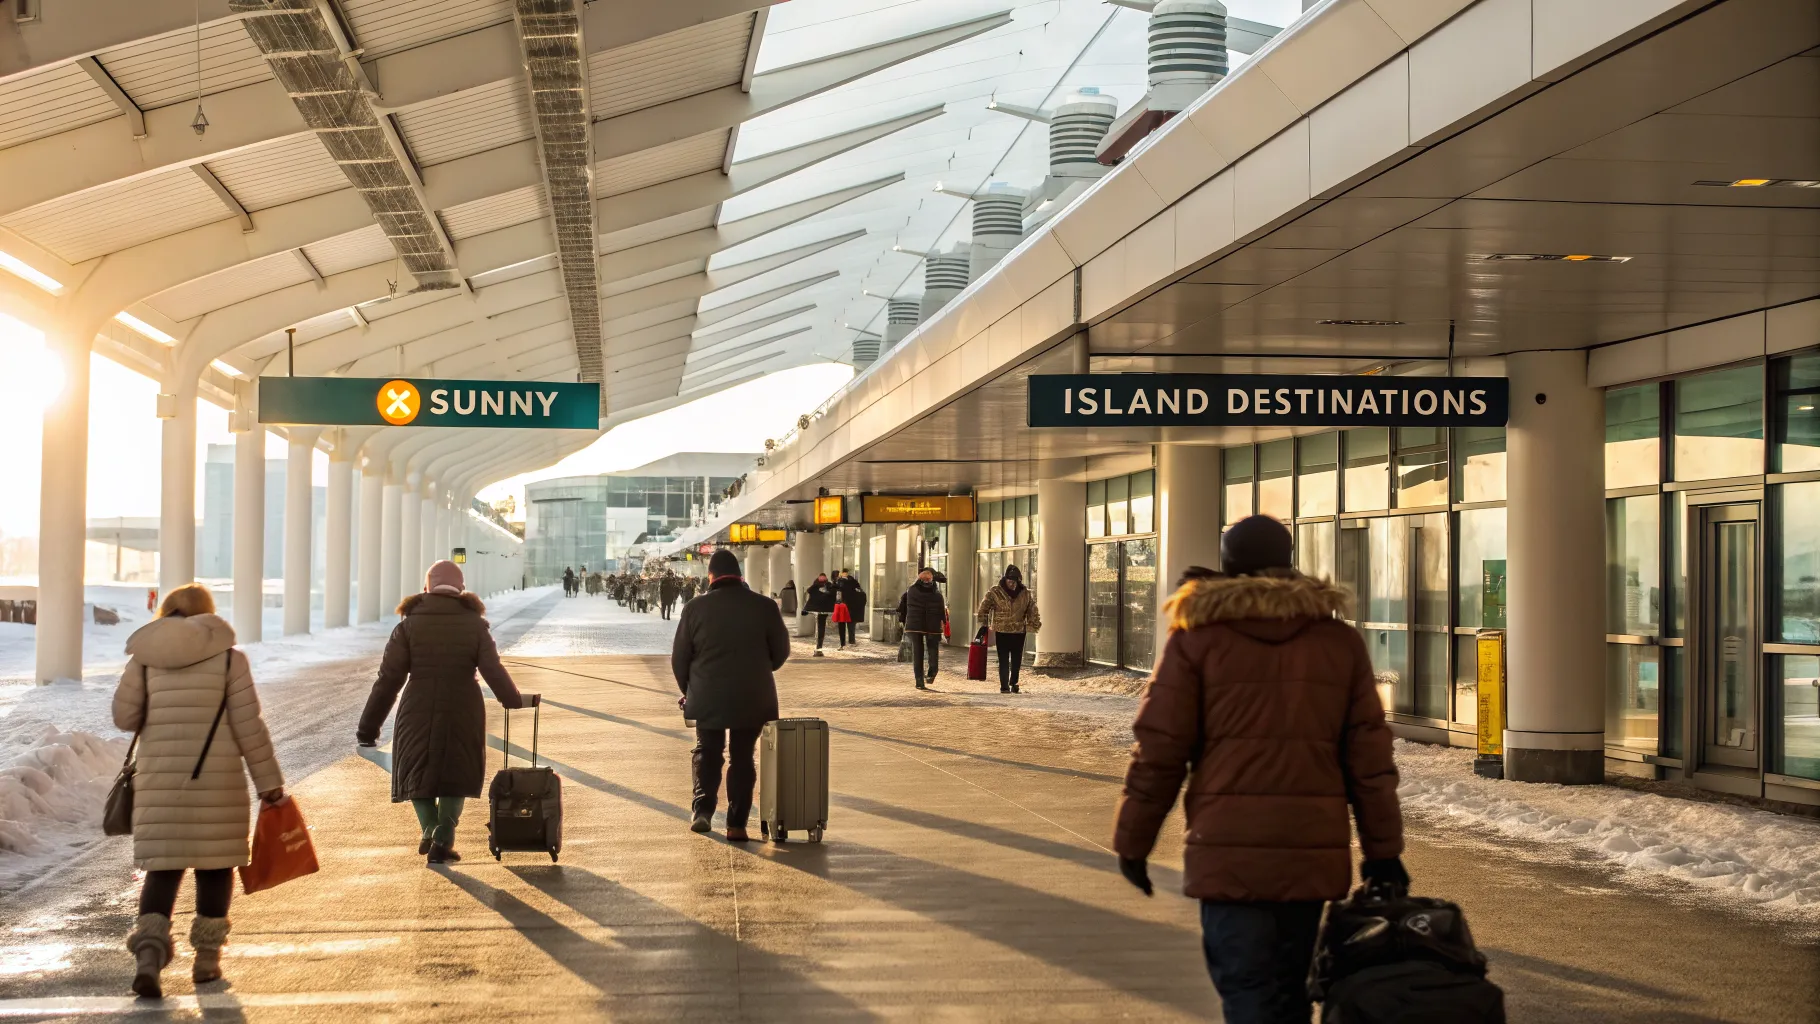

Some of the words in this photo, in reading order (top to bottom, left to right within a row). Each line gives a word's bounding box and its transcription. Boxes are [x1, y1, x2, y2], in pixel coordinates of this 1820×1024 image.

[429, 388, 559, 417] SUNNY
[1063, 387, 1210, 416] ISLAND
[1226, 388, 1488, 416] DESTINATIONS
